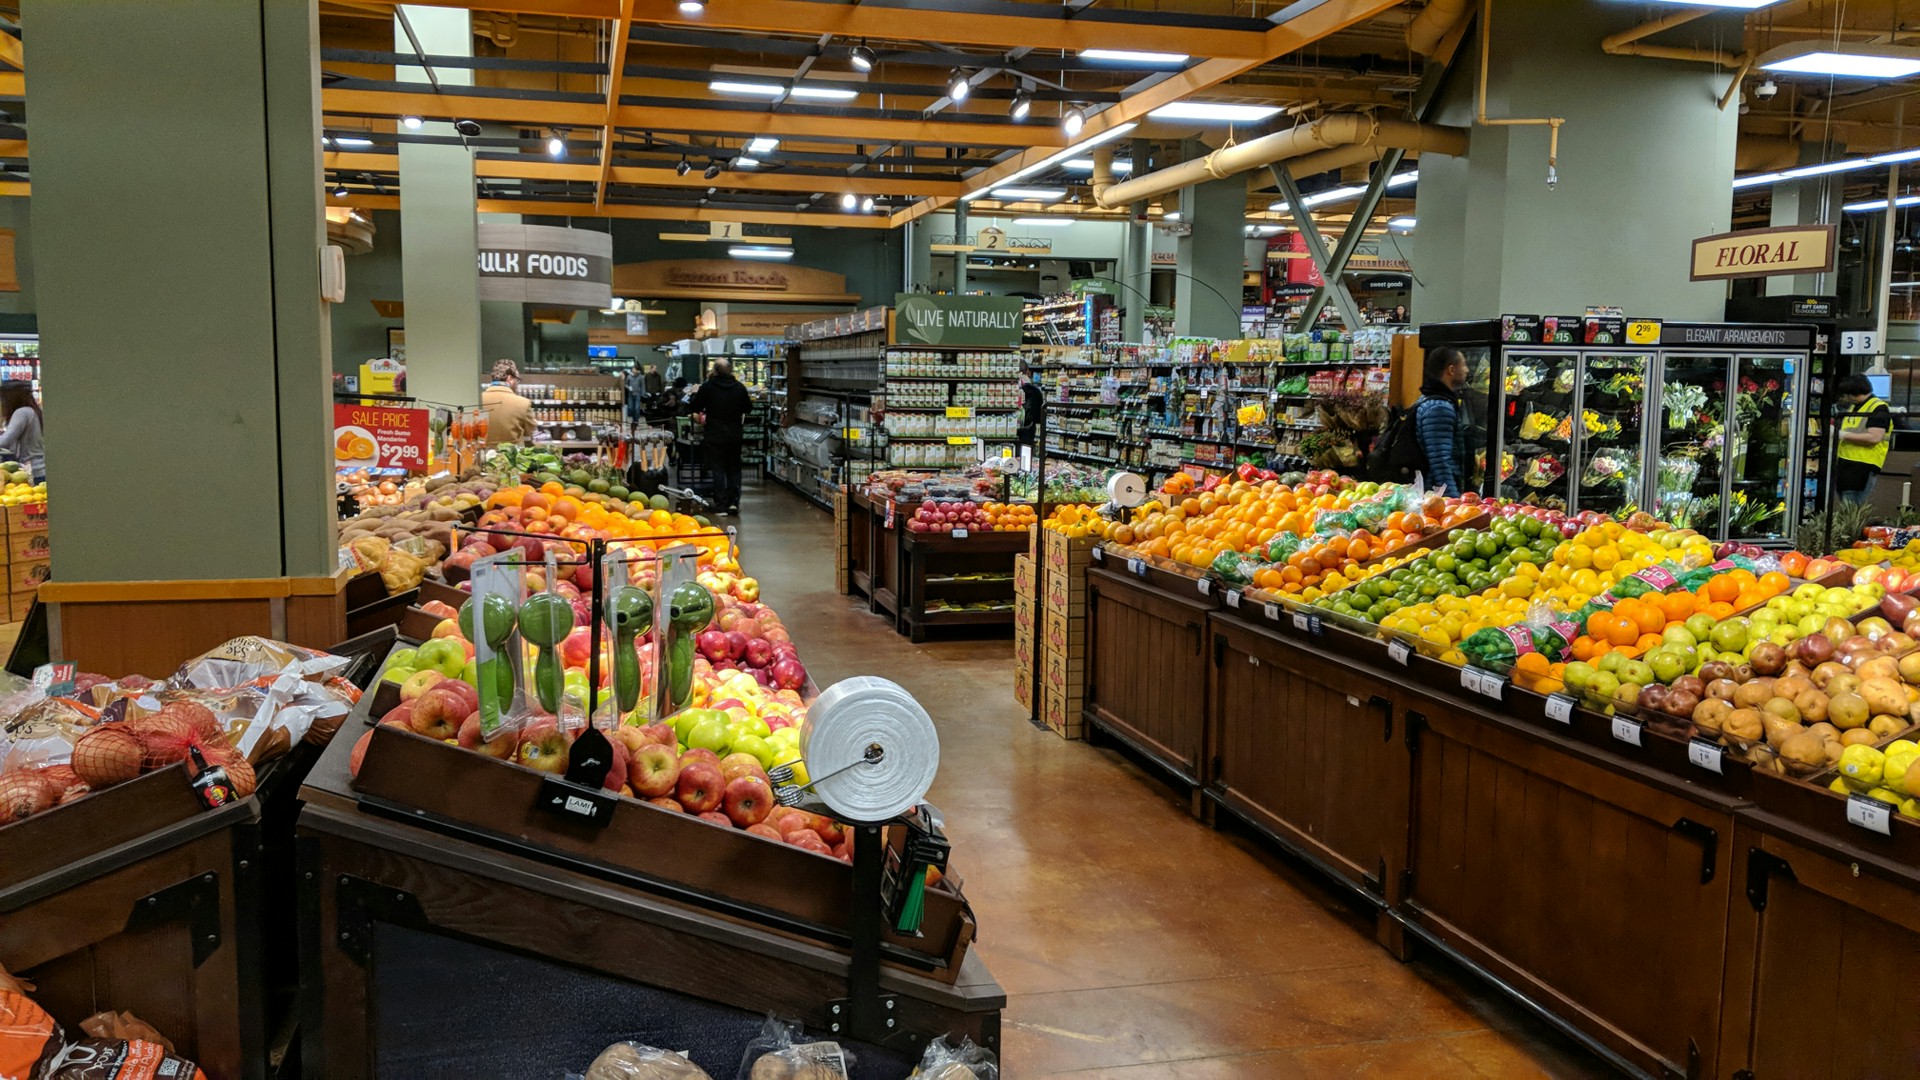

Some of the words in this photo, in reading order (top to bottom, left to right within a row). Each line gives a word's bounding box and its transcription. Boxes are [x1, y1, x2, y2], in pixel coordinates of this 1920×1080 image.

[722, 224, 732, 238] 1
[986, 235, 998, 249] 2
[1715, 241, 1800, 267] FLORAL
[478, 252, 520, 273] ULK
[527, 254, 589, 277] FOODS
[1387, 281, 1403, 289] goods
[917, 309, 944, 327] LIVE
[948, 310, 1020, 329] NATURALLY
[1513, 331, 1528, 341] $20
[1556, 332, 1569, 342] $15
[1597, 334, 1609, 343] $10
[1686, 328, 1722, 342] ELEGANT
[1723, 329, 1786, 344] ARRANGEMENTS
[1846, 336, 1854, 349] 3
[1863, 336, 1871, 349] 3
[352, 411, 379, 427] SALE
[382, 413, 410, 428] PRICE
